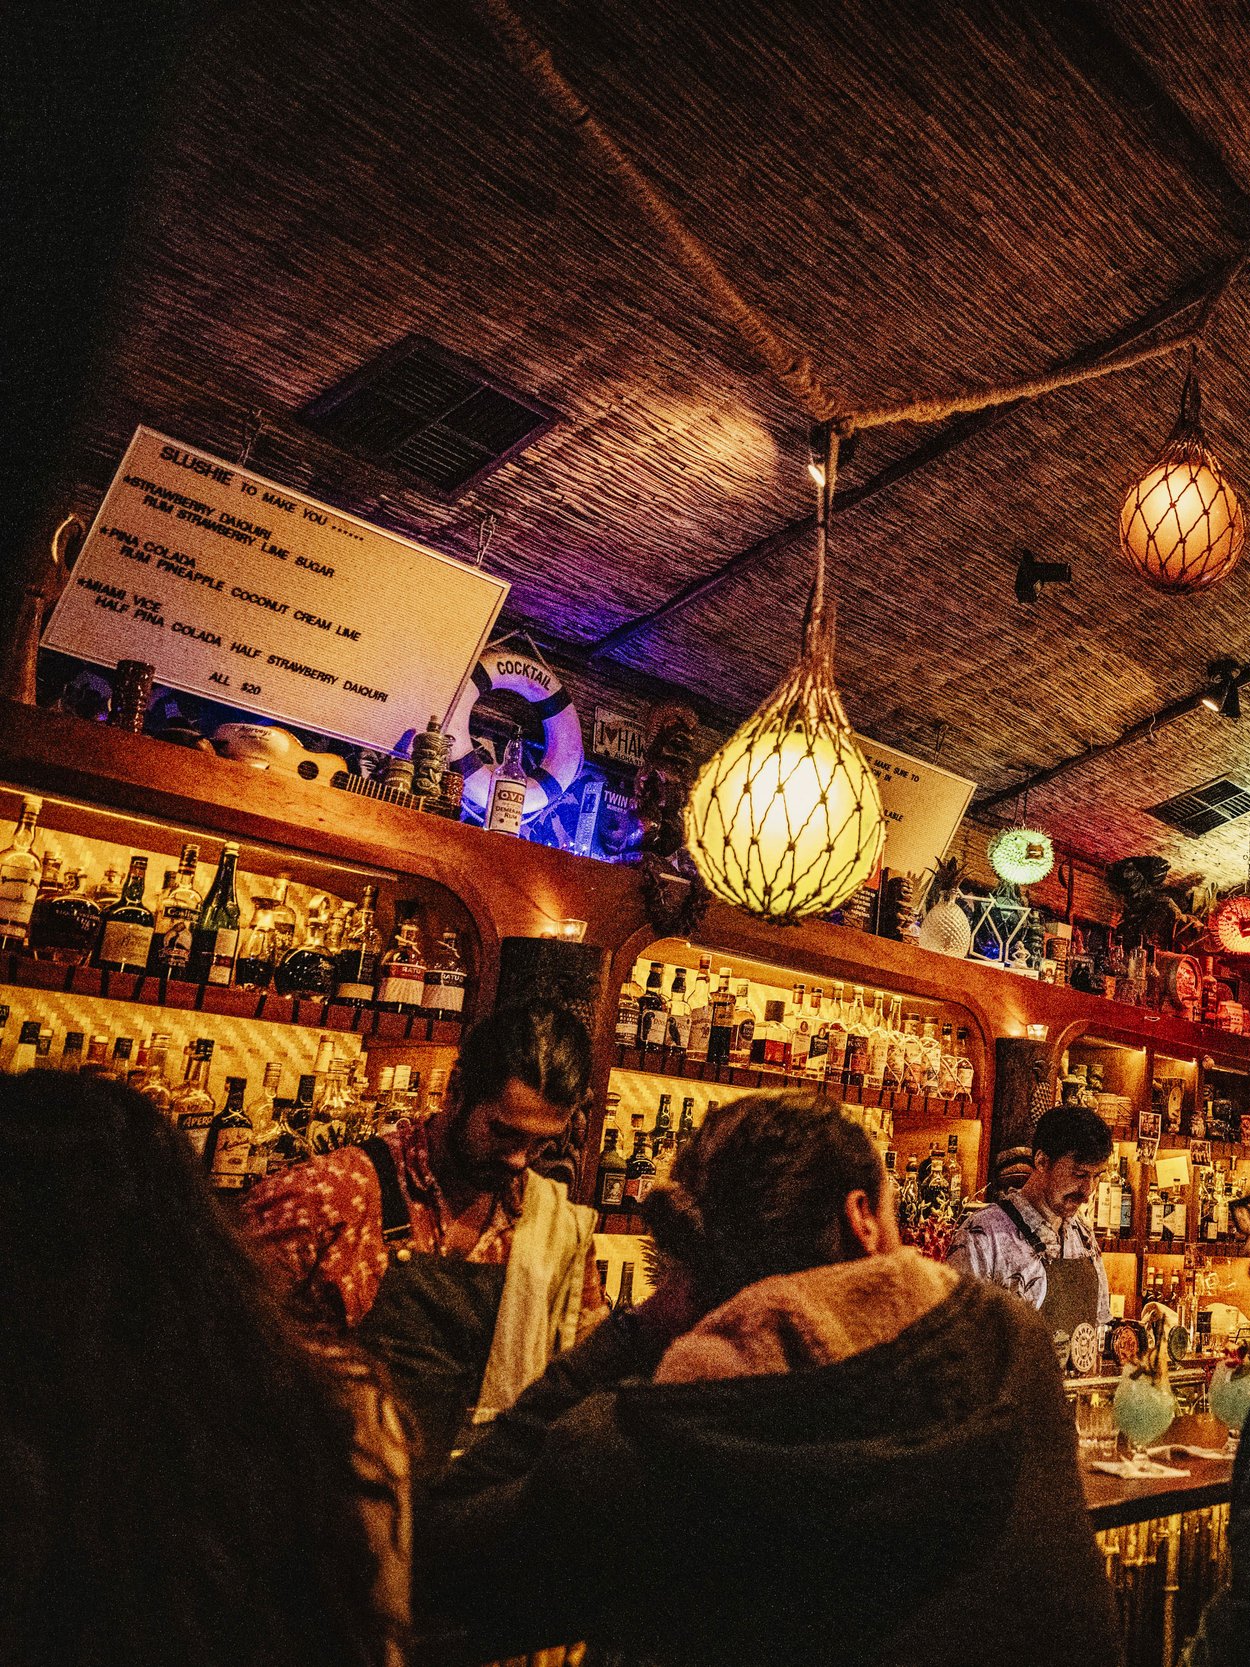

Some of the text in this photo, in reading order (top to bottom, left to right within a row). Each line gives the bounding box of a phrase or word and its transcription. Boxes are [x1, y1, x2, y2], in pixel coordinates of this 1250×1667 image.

[160, 446, 236, 486] SLUSHIE
[240, 482, 258, 496] TO
[262, 492, 297, 514] MAKE
[301, 508, 328, 526] YOU
[143, 494, 335, 578] RUM STRAWBERRY LIME SUGAR
[219, 512, 273, 541] DAIQUIRI
[143, 541, 197, 569] COLADA
[120, 545, 361, 642] RUM PINEAPPLE COCONUT CREAM LIME
[133, 595, 162, 613] VICE
[95, 596, 389, 703] HALF PINA COLADA HALF STRAWBERRY DAIQUIRI
[208, 672, 261, 696] ALL $20
[497, 661, 551, 691] COCKTAIL
[874, 760, 892, 771] MAKE
[893, 767, 909, 779] SURE
[911, 774, 920, 783] TO
[604, 790, 628, 808] TWIN
